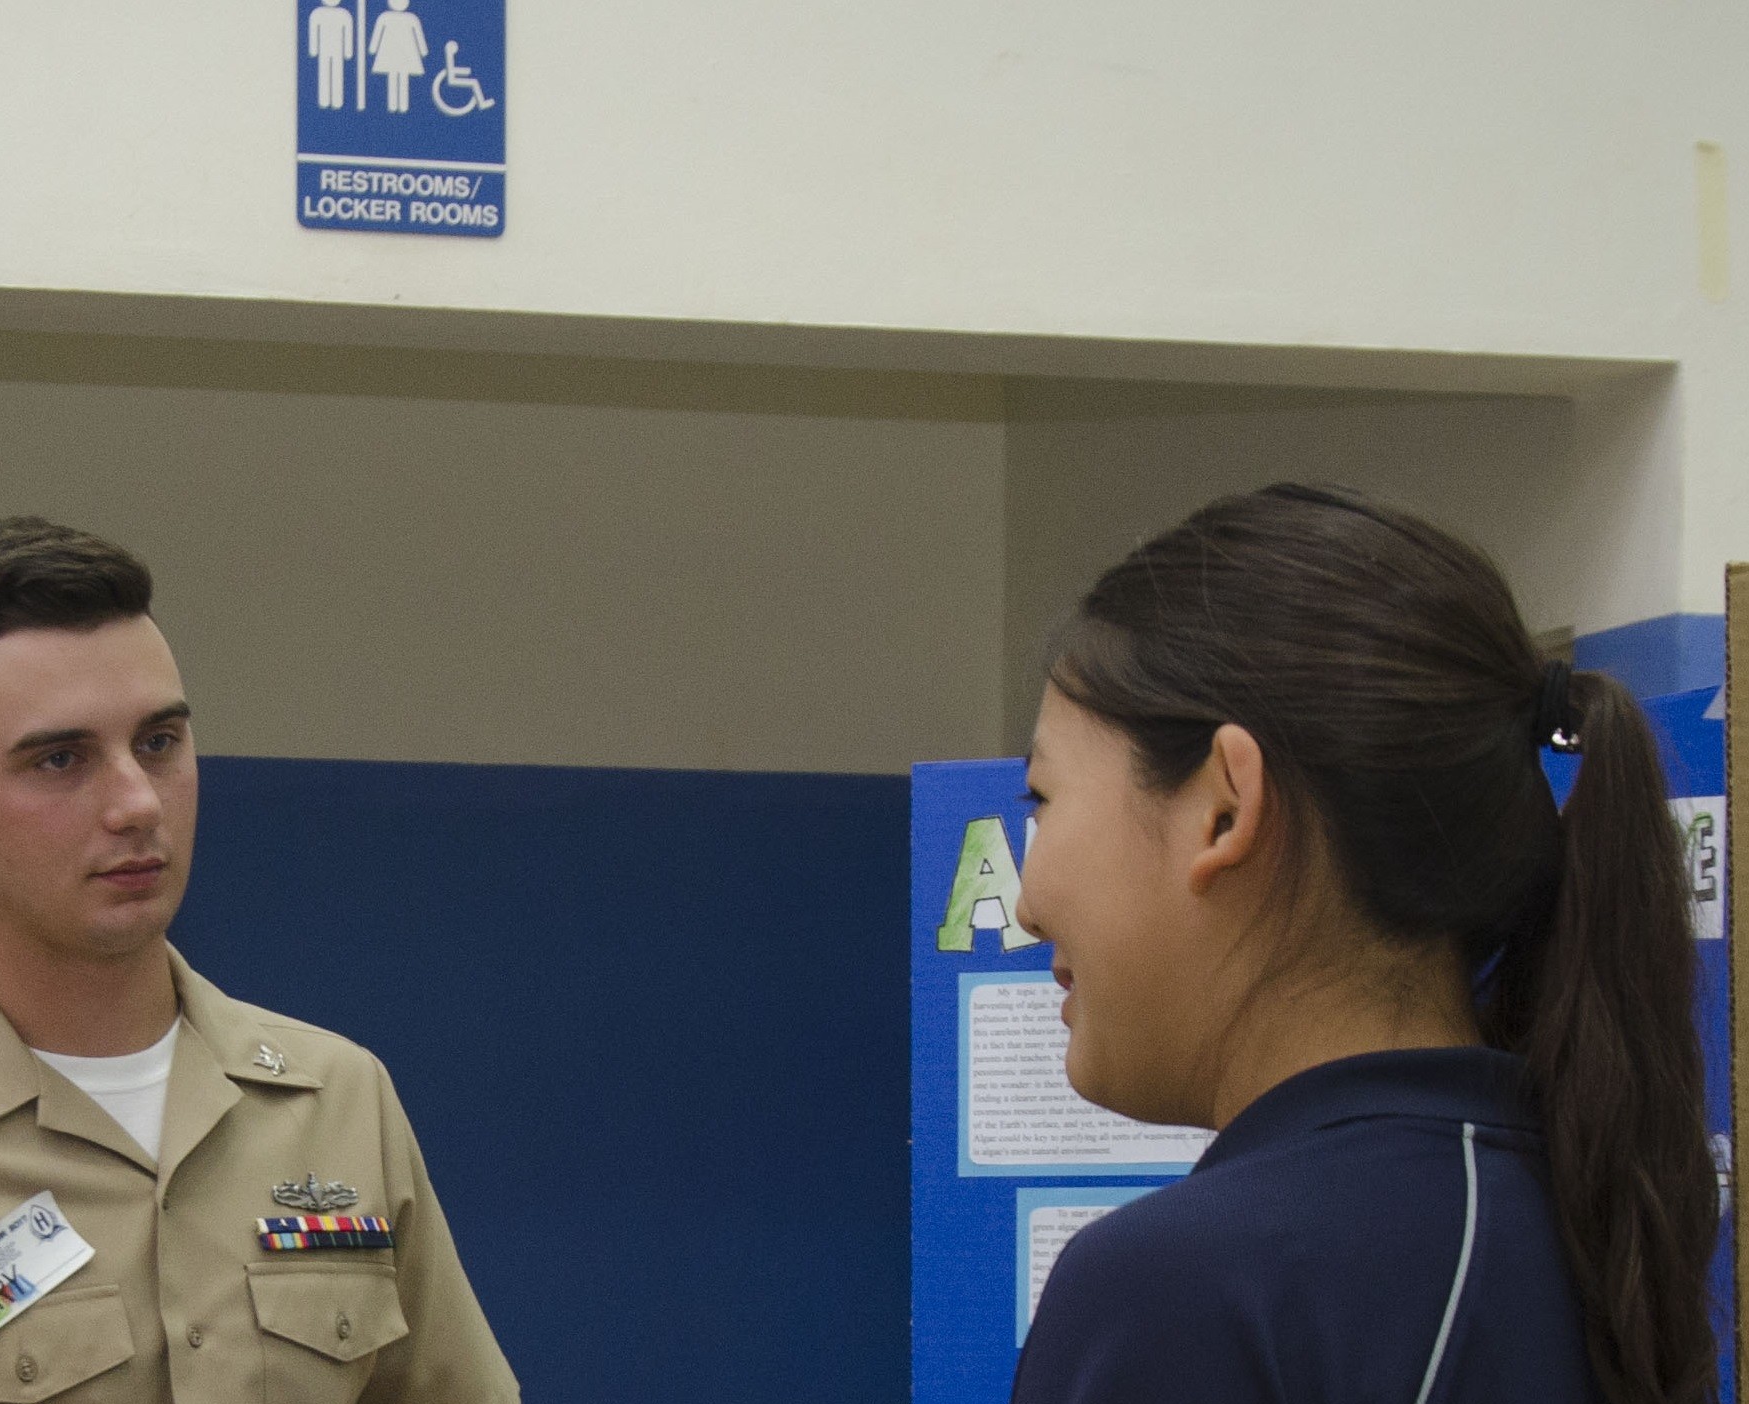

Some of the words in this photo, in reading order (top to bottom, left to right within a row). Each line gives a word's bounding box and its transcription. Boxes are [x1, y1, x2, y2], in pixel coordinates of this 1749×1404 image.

[320, 170, 483, 200] RESTROOMS/
[304, 196, 402, 222] LOCKER
[410, 200, 499, 228] ROOMS
